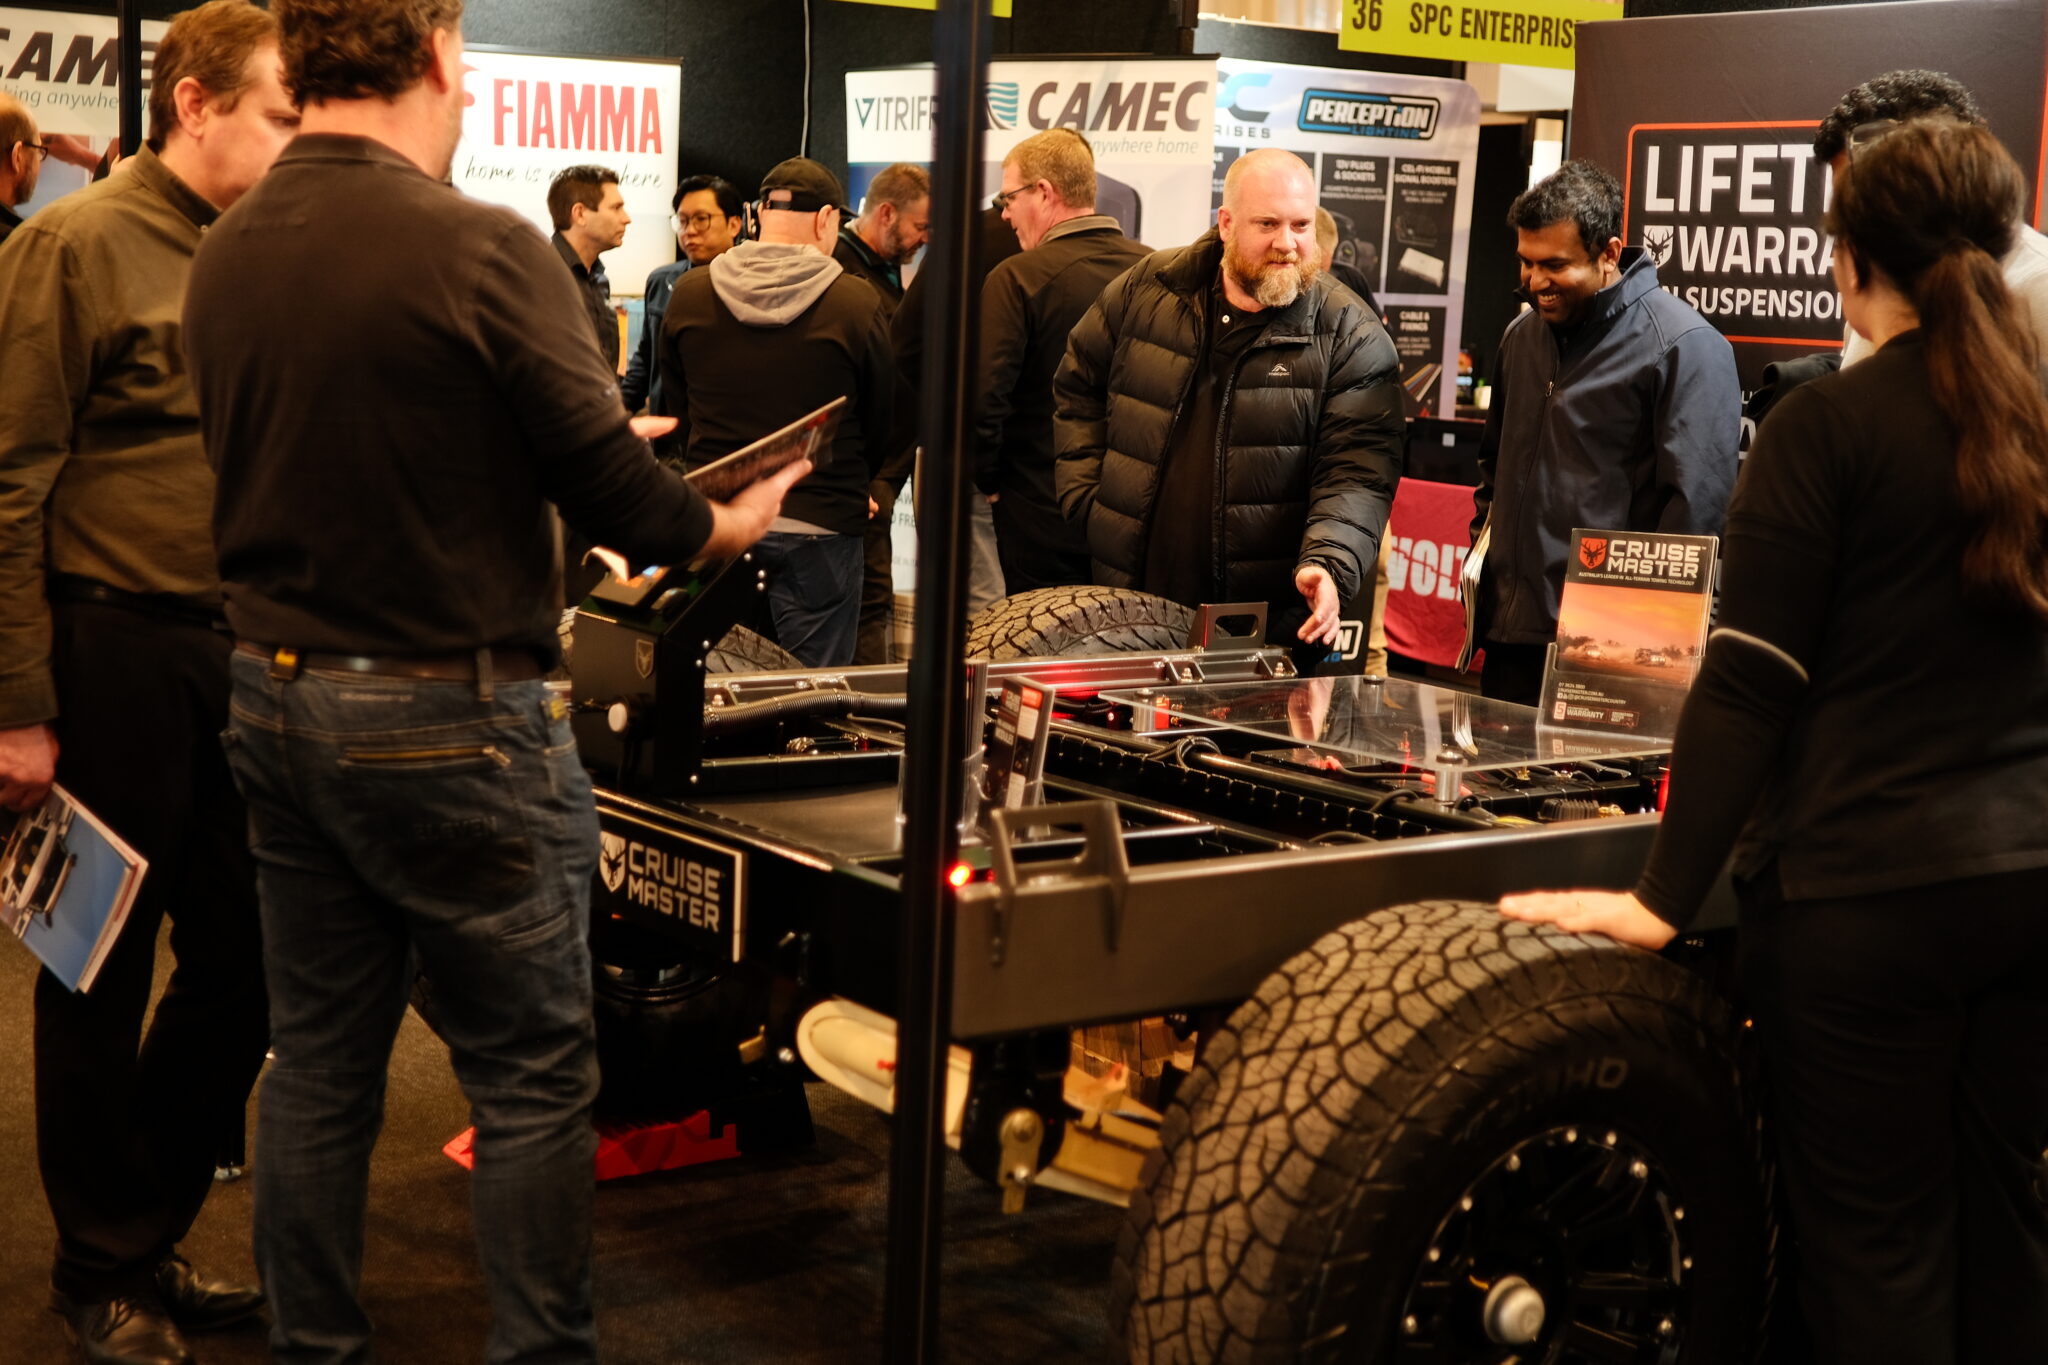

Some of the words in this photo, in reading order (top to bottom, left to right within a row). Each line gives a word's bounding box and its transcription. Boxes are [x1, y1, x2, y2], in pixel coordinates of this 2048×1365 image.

[1352, 0, 1382, 31] 36
[1410, 2, 1453, 36] SPC
[1460, 7, 1575, 48] ENTERPRIS
[493, 78, 662, 154] FIAMMA
[1028, 80, 1209, 132] CAMEC
[1351, 126, 1421, 139] LIGHTING
[1091, 138, 1153, 157] nywhere
[1155, 138, 1200, 154] home
[465, 155, 516, 181] home
[524, 169, 539, 183] is
[1342, 171, 1376, 183] SOCKETS
[1609, 539, 1702, 563] CRUISE
[1606, 556, 1699, 579] MASTER
[1667, 579, 1695, 587] TECHNOLOGY
[1566, 708, 1605, 720] WARRANTY
[628, 841, 721, 902] CRUISE
[628, 873, 720, 933] MASTER
